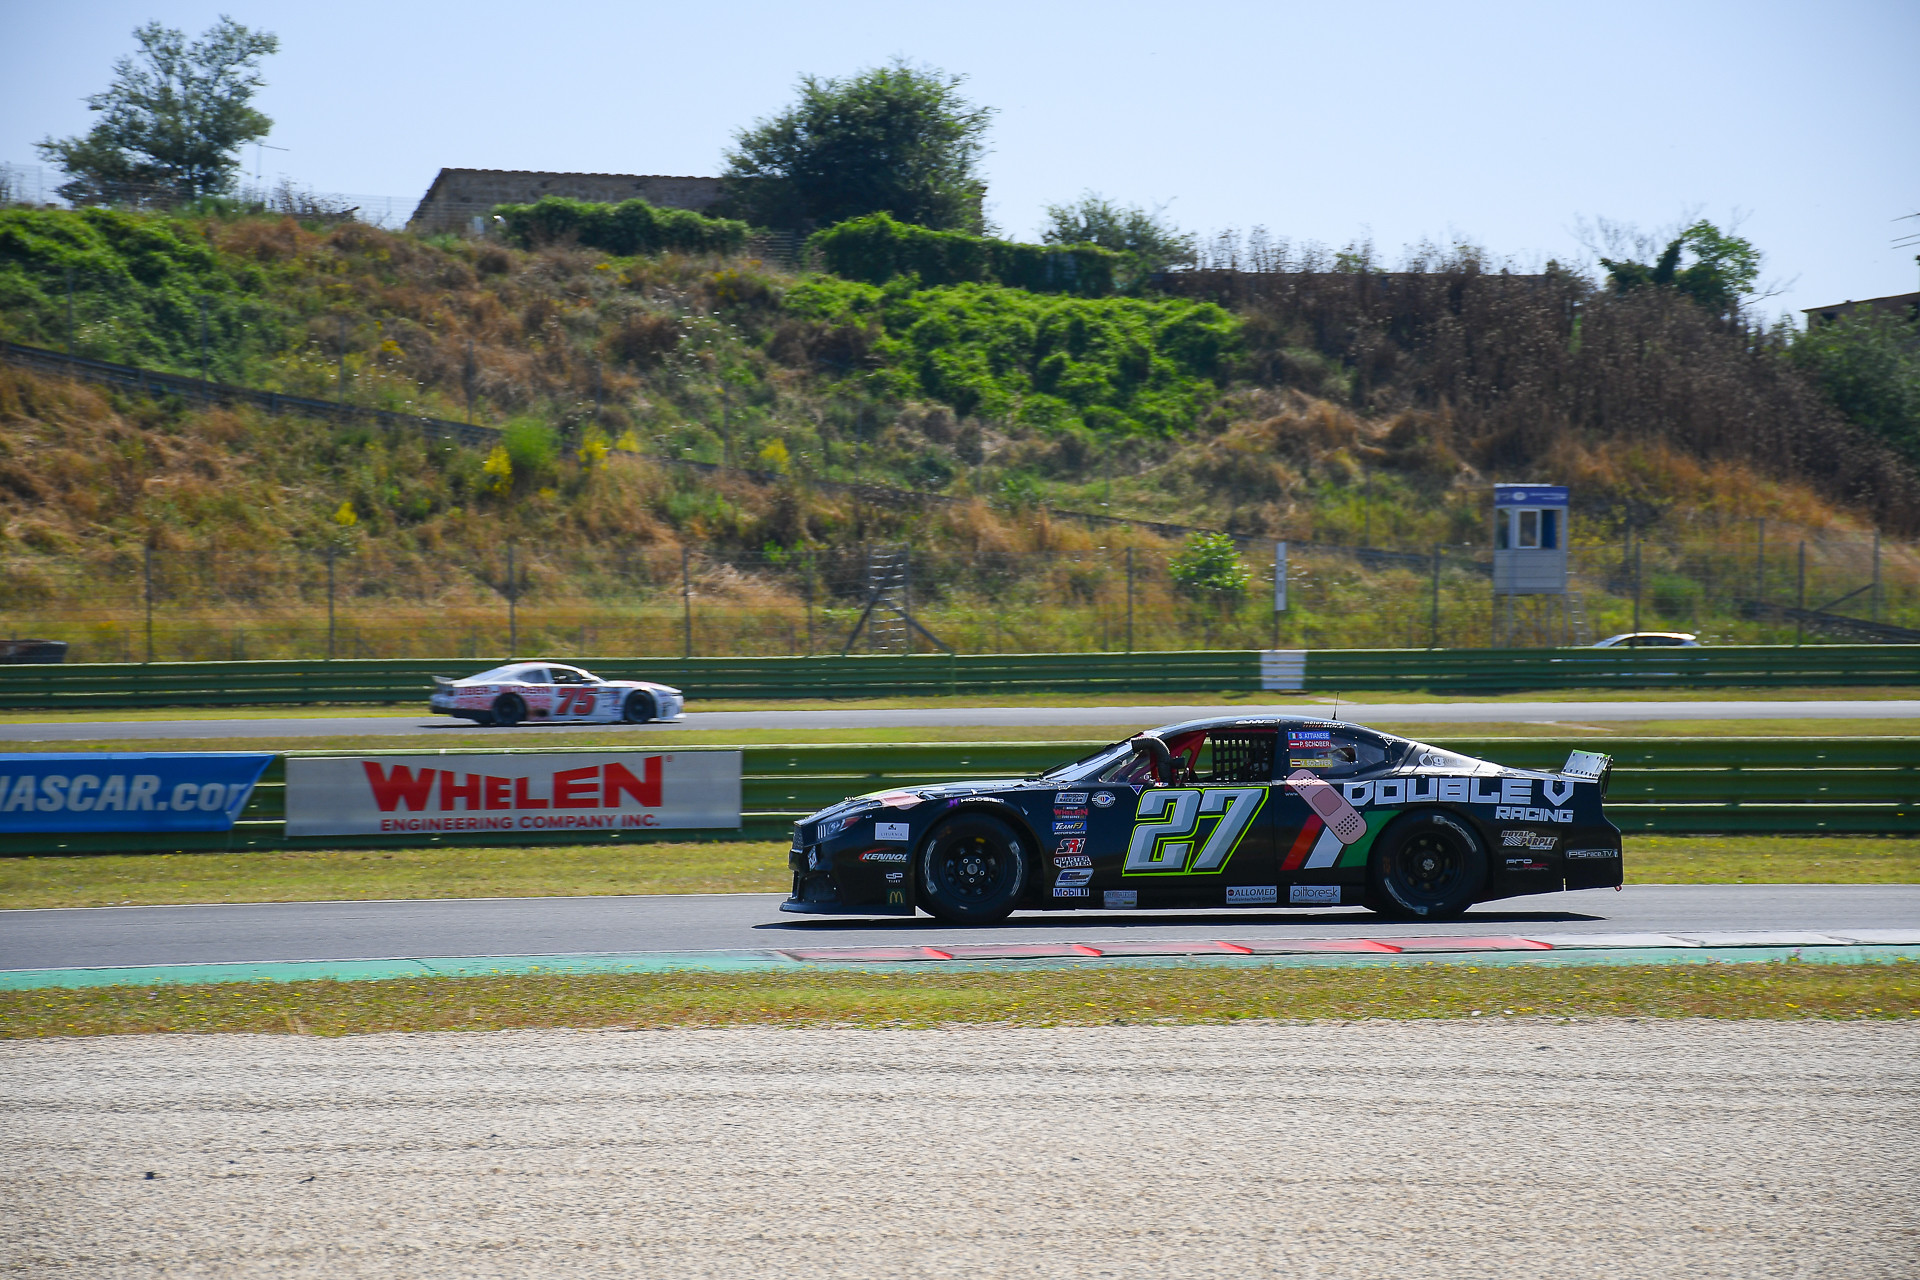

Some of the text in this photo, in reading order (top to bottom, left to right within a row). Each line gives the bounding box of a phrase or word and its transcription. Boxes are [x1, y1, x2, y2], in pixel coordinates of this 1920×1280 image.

[555, 688, 597, 715] 75
[362, 756, 662, 811] WHELEN
[1343, 777, 1574, 806] DOUBLE V
[1053, 808, 1088, 816] WHELEN
[1495, 806, 1574, 823] RACING
[380, 813, 661, 831] ENGINEERING COMPANY INC.
[1122, 787, 1269, 877] 27
[1501, 830, 1529, 838] ROYAL
[1520, 836, 1557, 846] PURPLE
[1054, 856, 1089, 864] QUARTER
[1054, 888, 1079, 897] Mobil
[1234, 888, 1276, 897] ALLOMED
